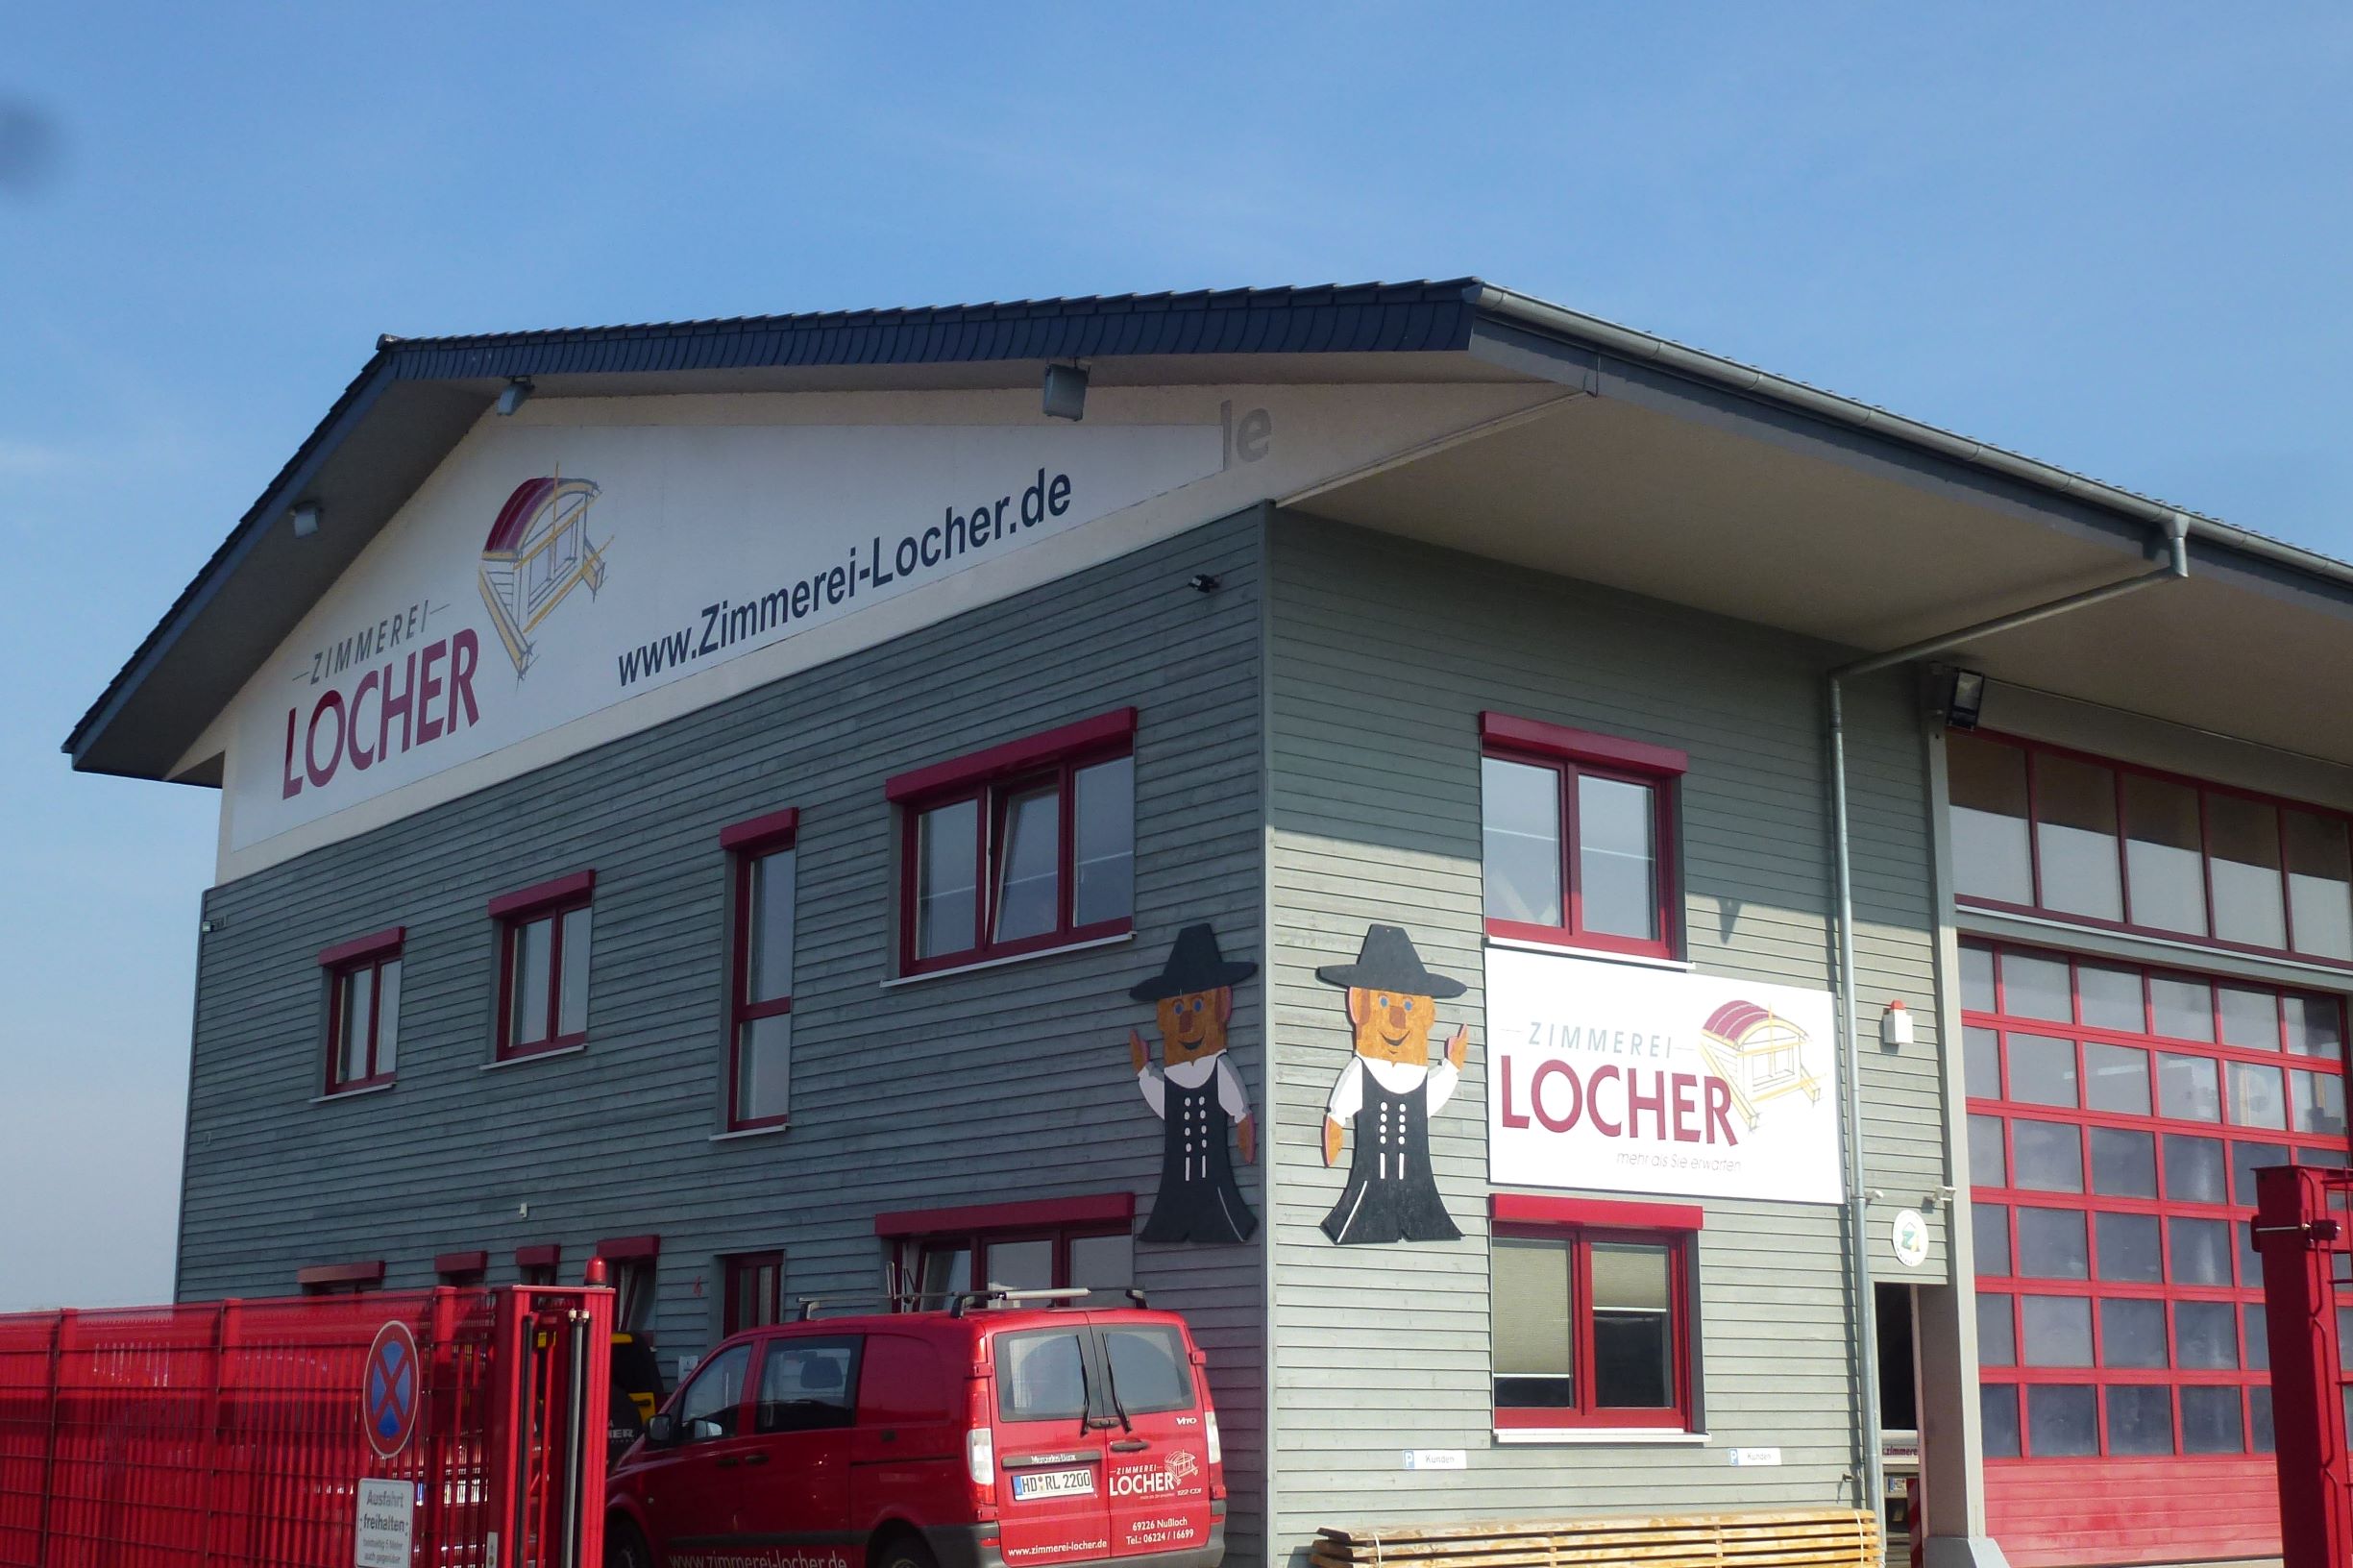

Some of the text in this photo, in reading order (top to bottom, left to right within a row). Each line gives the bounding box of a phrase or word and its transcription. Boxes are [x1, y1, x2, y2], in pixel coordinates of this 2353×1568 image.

[618, 468, 1072, 687] www.Zimmerei-Locher.de
[309, 600, 429, 685] ZIMMEREI
[282, 627, 480, 800] LOCHER
[1528, 1021, 1672, 1059] ZIMMEREI
[1500, 1054, 1739, 1147] LOCHER
[1617, 1152, 1649, 1166] mehr
[1670, 1153, 1688, 1169] Sie
[1425, 1454, 1455, 1464] Kunden
[1115, 1463, 1157, 1475] ZIMMEREI
[1021, 1472, 1091, 1493] HD RL 2200
[1109, 1471, 1175, 1497] LOCHER
[366, 1490, 404, 1508] Ausfahrt
[363, 1513, 404, 1532] freihalten
[1132, 1516, 1188, 1531] 69226 Nußloch
[1126, 1535, 1142, 1546] Tel.:
[1143, 1532, 1165, 1543] 06224
[1172, 1529, 1194, 1540] 16699
[1008, 1539, 1107, 1556] www.zimmerei-locher.de
[669, 1549, 846, 1568] wwwzimmerei-locherde
